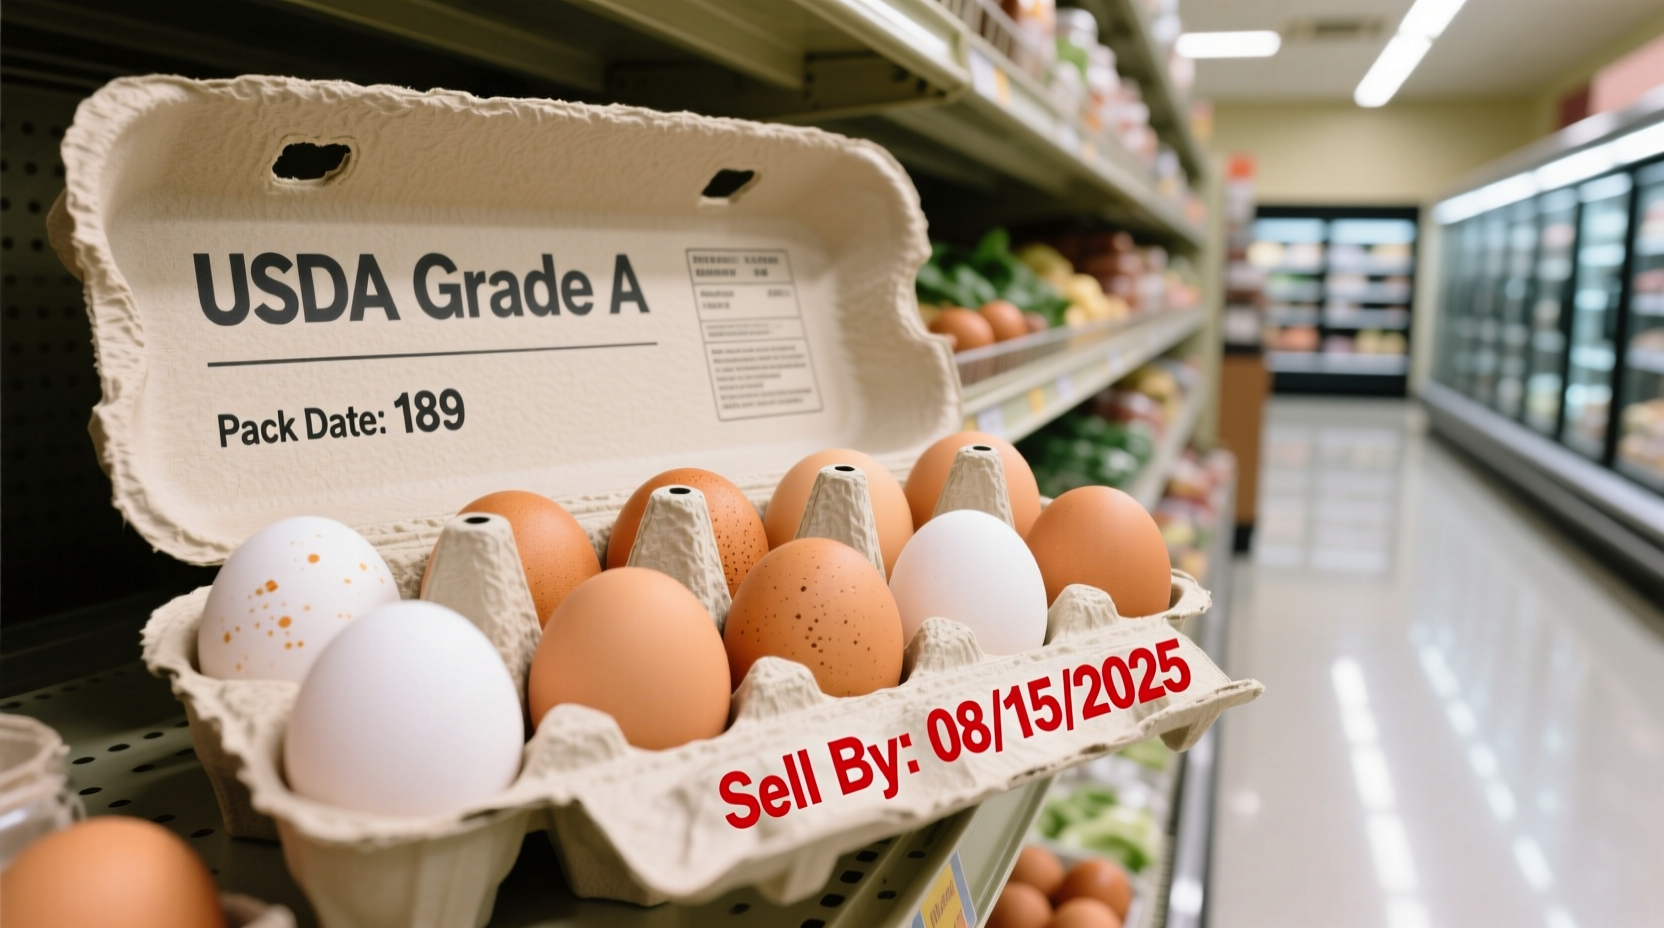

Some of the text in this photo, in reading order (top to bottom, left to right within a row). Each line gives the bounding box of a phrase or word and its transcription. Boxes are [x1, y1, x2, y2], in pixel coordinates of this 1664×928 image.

[192, 251, 650, 327] USDA Grade A
[217, 388, 465, 448] Pack Date: 189
[718, 638, 1191, 829] Sell By: 08/15/2025
